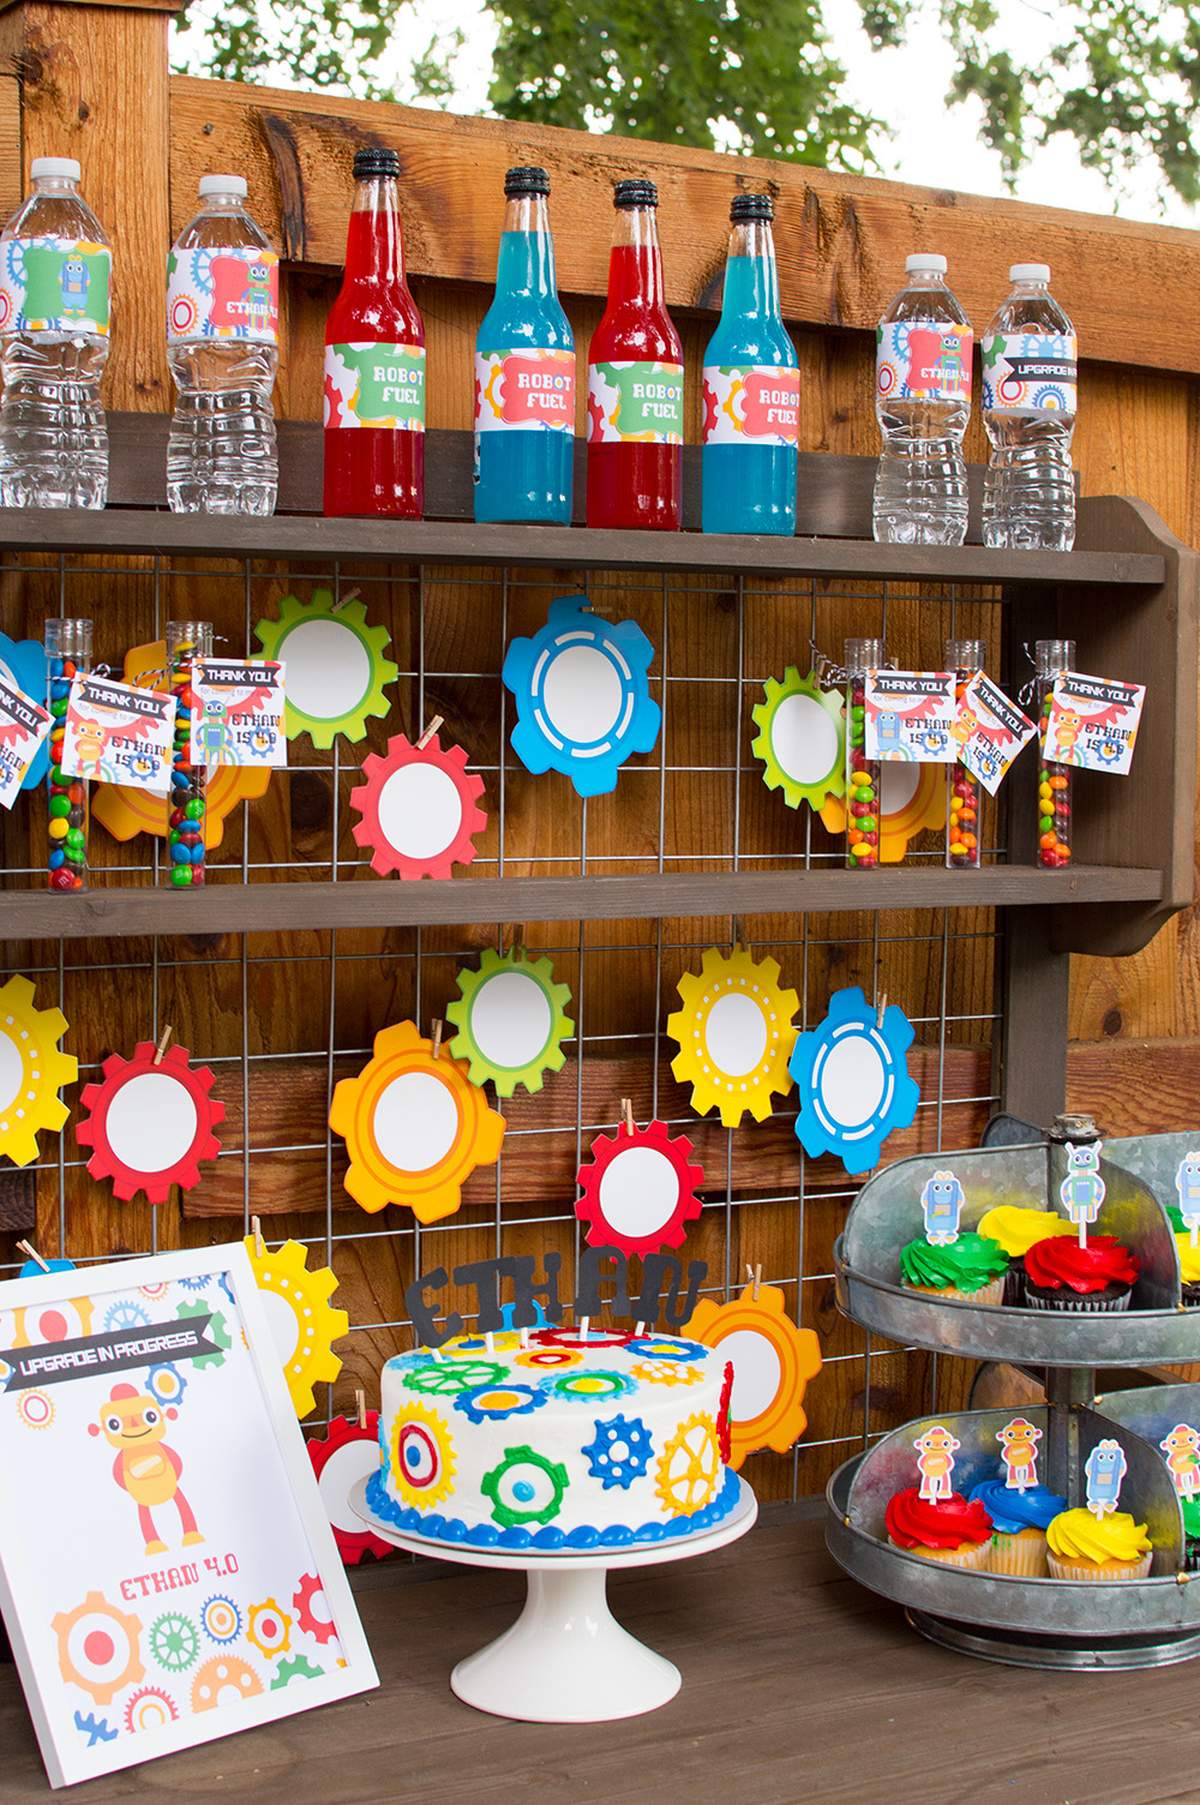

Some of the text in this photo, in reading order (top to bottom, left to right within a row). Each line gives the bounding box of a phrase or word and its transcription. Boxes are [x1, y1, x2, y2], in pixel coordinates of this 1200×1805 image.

[374, 366, 424, 386] ROBOT
[1018, 364, 1067, 376] UPGRADE
[518, 373, 572, 391] ROBOT
[382, 386, 420, 405] FUEL
[527, 392, 567, 410] FUEL
[633, 383, 682, 401] ROBOT
[760, 389, 800, 408] ROBOT
[642, 402, 679, 420] FUEL
[767, 409, 798, 425] FUEL
[207, 669, 272, 682] THANK YOU
[880, 680, 943, 692] THANK YOU
[1068, 681, 1105, 698] THANK
[1106, 689, 1130, 702] YOU
[88, 687, 131, 707] THANK
[133, 698, 160, 714] YOU
[980, 686, 1006, 717] THANK
[1004, 716, 1023, 733] YOU
[15, 703, 38, 728] YOU
[232, 713, 280, 727] ETHAN
[905, 717, 952, 730] ETHAN
[237, 731, 251, 744] IS
[910, 733, 923, 744] IS
[1085, 722, 1132, 741] ETHAN
[111, 735, 167, 757] ETHAN
[976, 732, 1008, 768] ETHAN
[1086, 738, 1100, 750] IS
[115, 753, 132, 767] IS
[405, 1246, 708, 1349] ETHAN
[19, 1330, 199, 1377] UPGRADE IN PROGRESS
[120, 1552, 239, 1601] ETHAN 4.0
